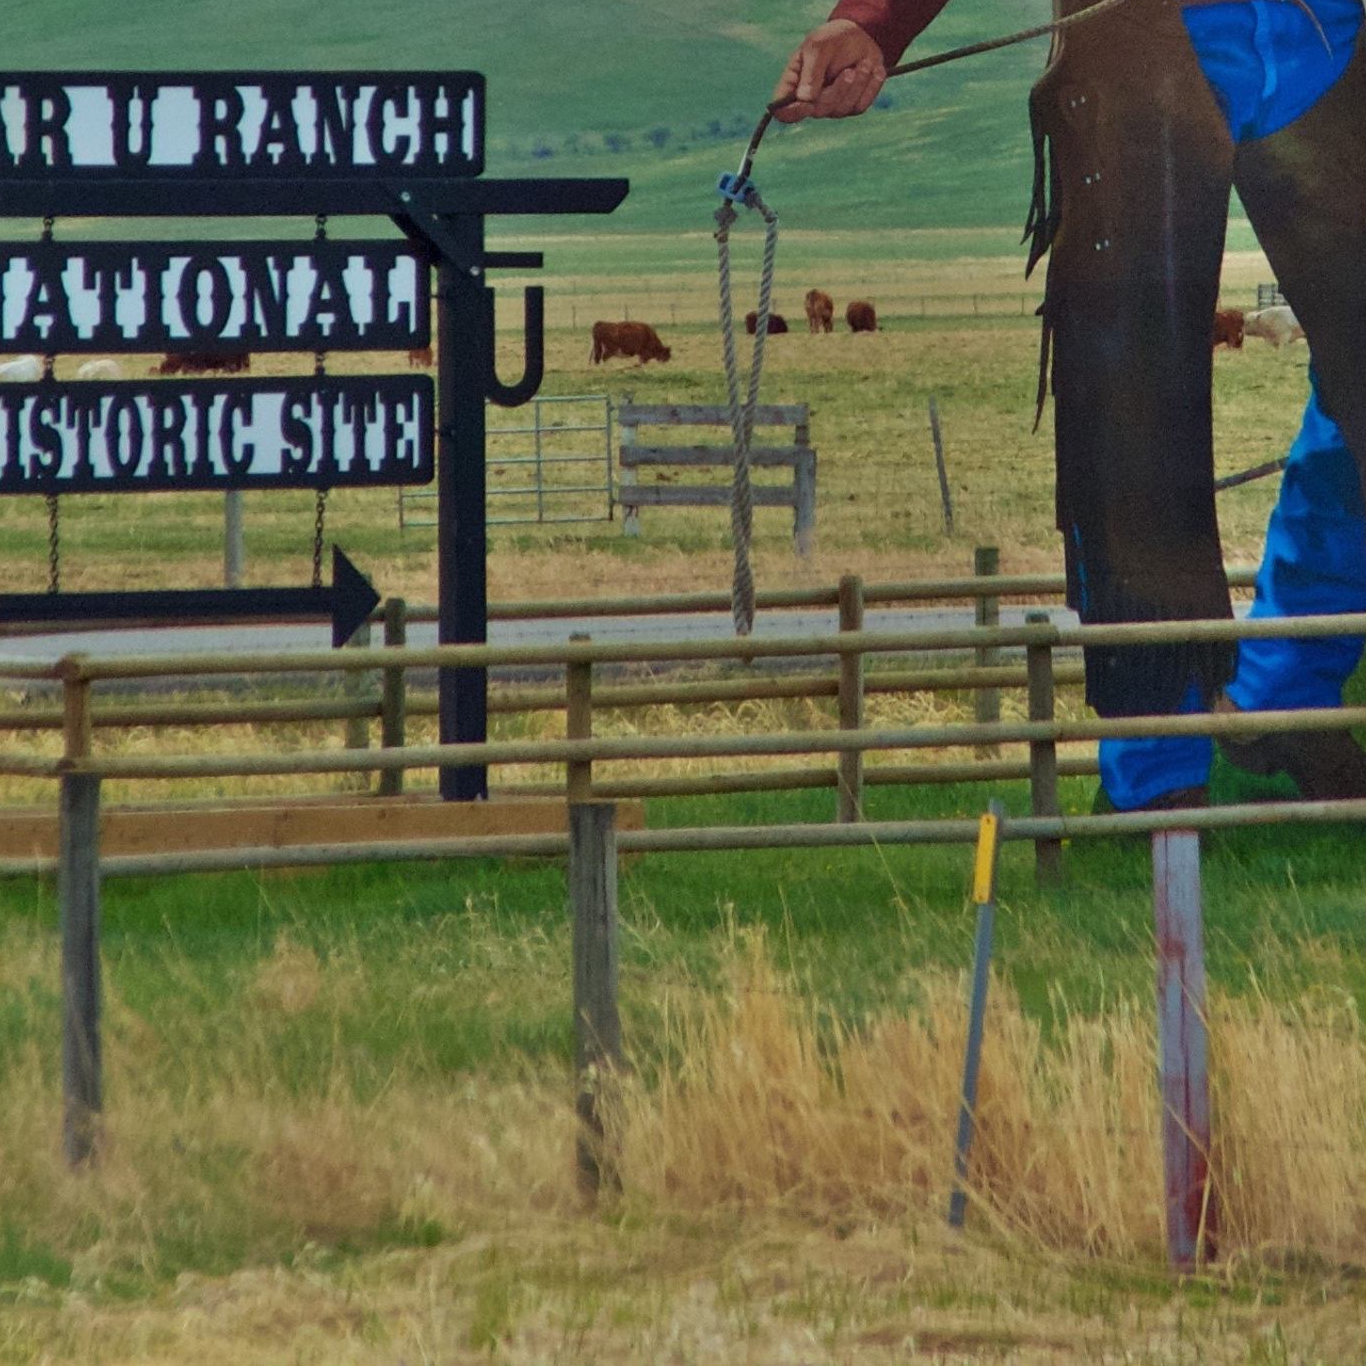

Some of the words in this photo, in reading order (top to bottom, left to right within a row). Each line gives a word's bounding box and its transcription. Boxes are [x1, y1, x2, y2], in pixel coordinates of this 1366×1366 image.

[107, 84, 159, 166] U
[192, 84, 471, 166] RANCH
[280, 391, 416, 475] SITE
